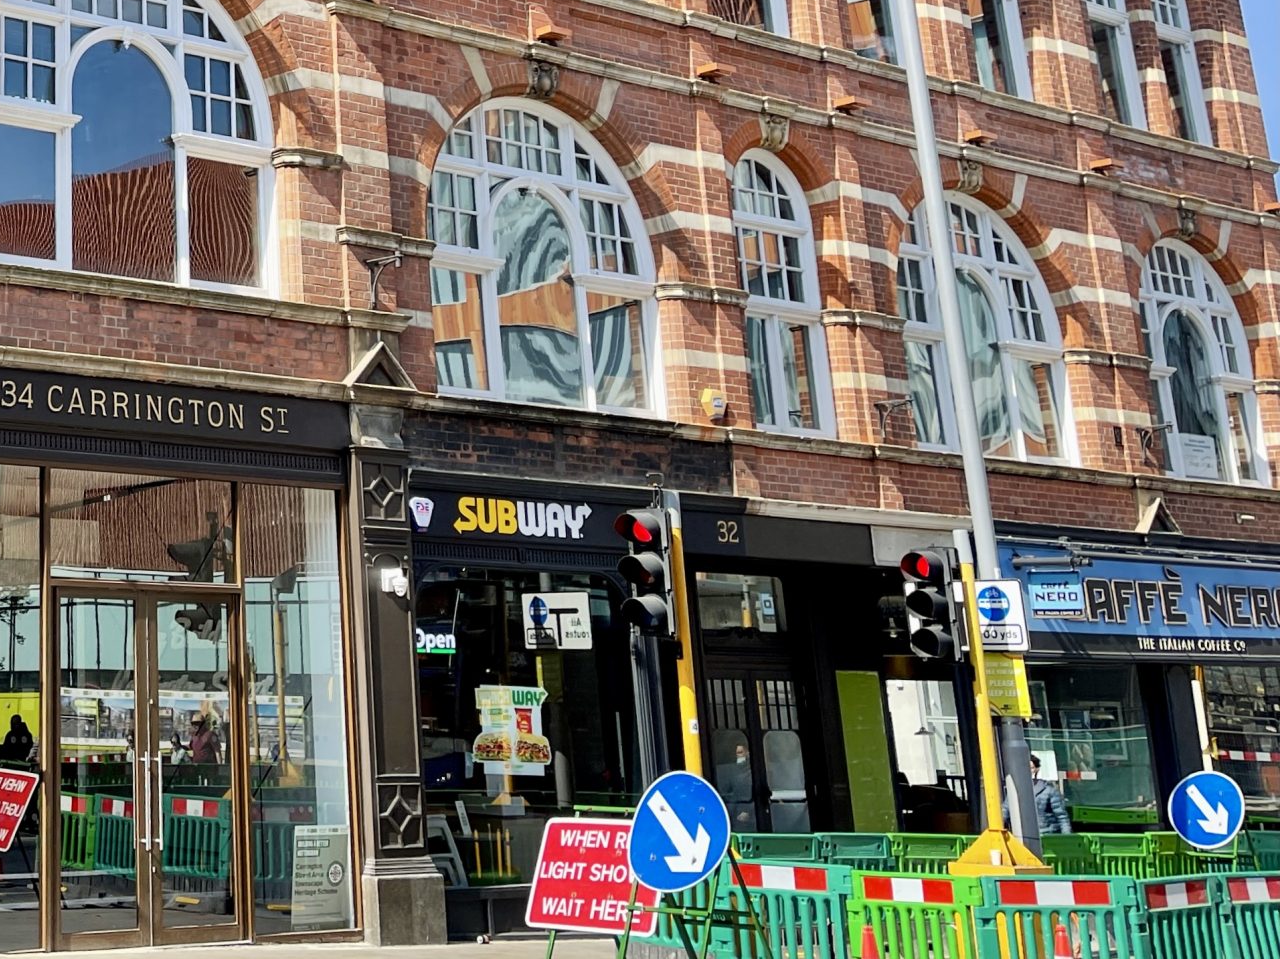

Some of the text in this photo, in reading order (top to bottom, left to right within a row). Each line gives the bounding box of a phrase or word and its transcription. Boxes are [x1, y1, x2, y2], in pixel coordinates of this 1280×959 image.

[0, 380, 290, 433] 34 CARRINGTON ST
[453, 496, 593, 539] SUBWAY
[717, 520, 739, 543] 32
[1035, 591, 1078, 602] NERO
[1070, 566, 1189, 626] AFFÈ
[416, 627, 456, 653] Open
[1000, 629, 1018, 640] yds
[1137, 637, 1155, 650] THE
[1159, 638, 1195, 651] ITALIAN
[1198, 639, 1232, 651] COFFEE
[512, 690, 546, 706] WAY
[560, 829, 610, 849] WHEN
[540, 861, 634, 884] LIGHT SHO
[542, 897, 644, 924] WAIT HERE
